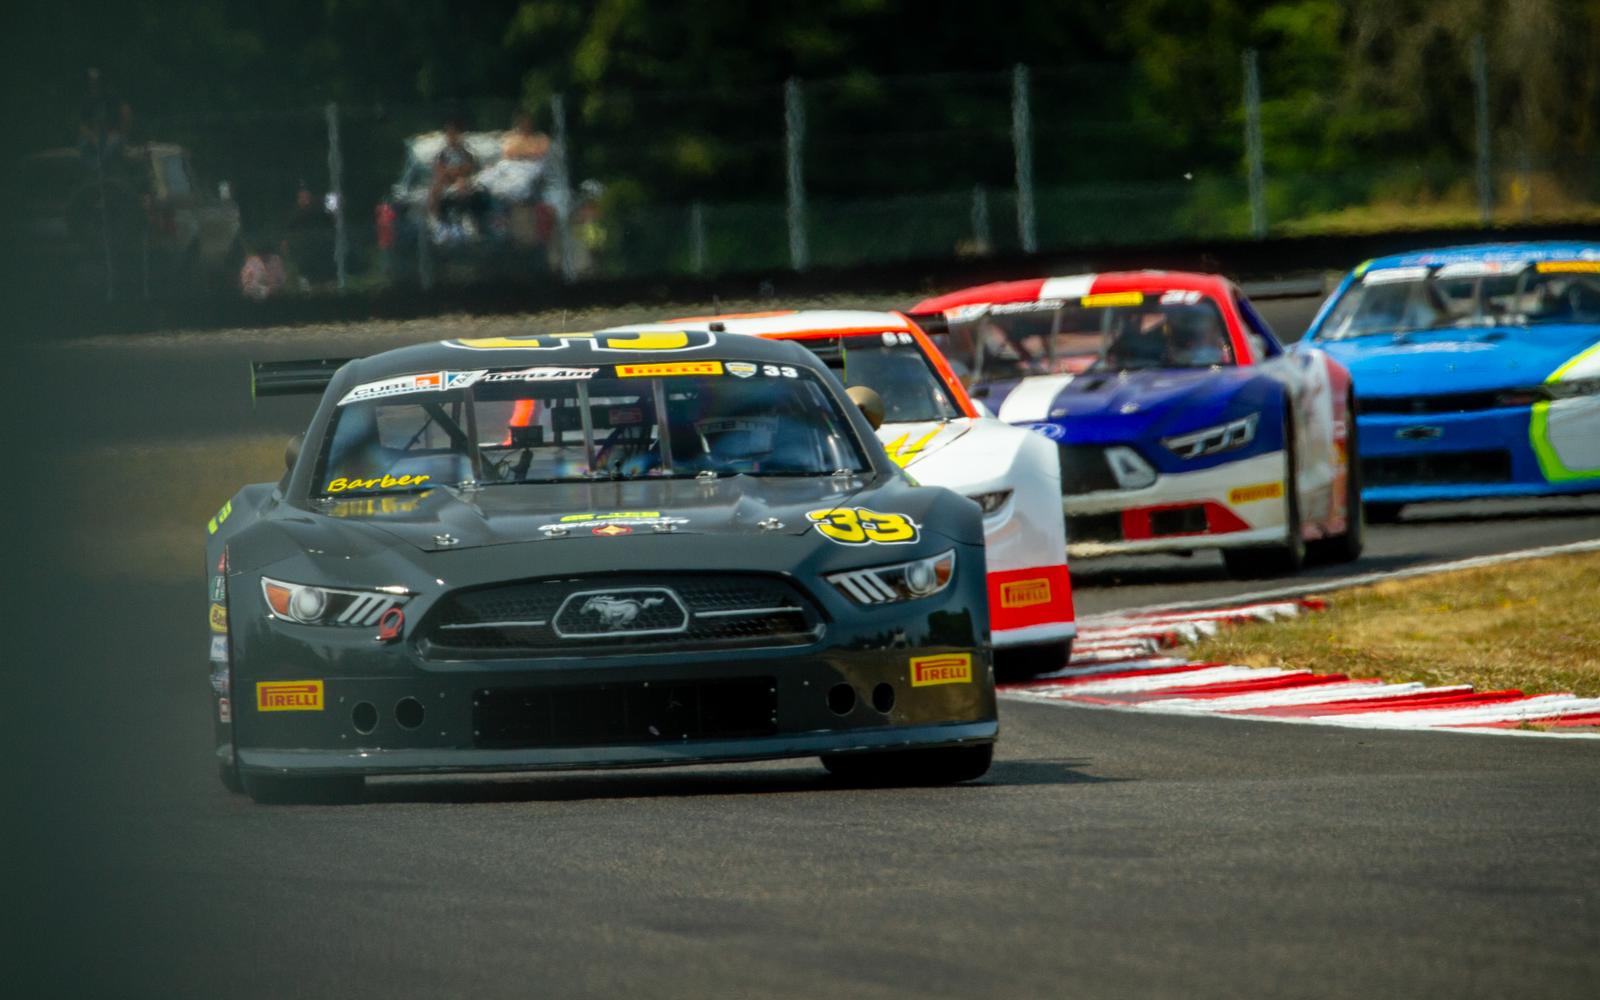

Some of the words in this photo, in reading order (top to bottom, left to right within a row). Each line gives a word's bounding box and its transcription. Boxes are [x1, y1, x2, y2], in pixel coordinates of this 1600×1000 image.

[763, 365, 799, 379] 33
[328, 474, 430, 492] Barber
[806, 507, 920, 546] 33
[915, 658, 967, 682] PIRELLI
[260, 685, 318, 707] PIRELLI
